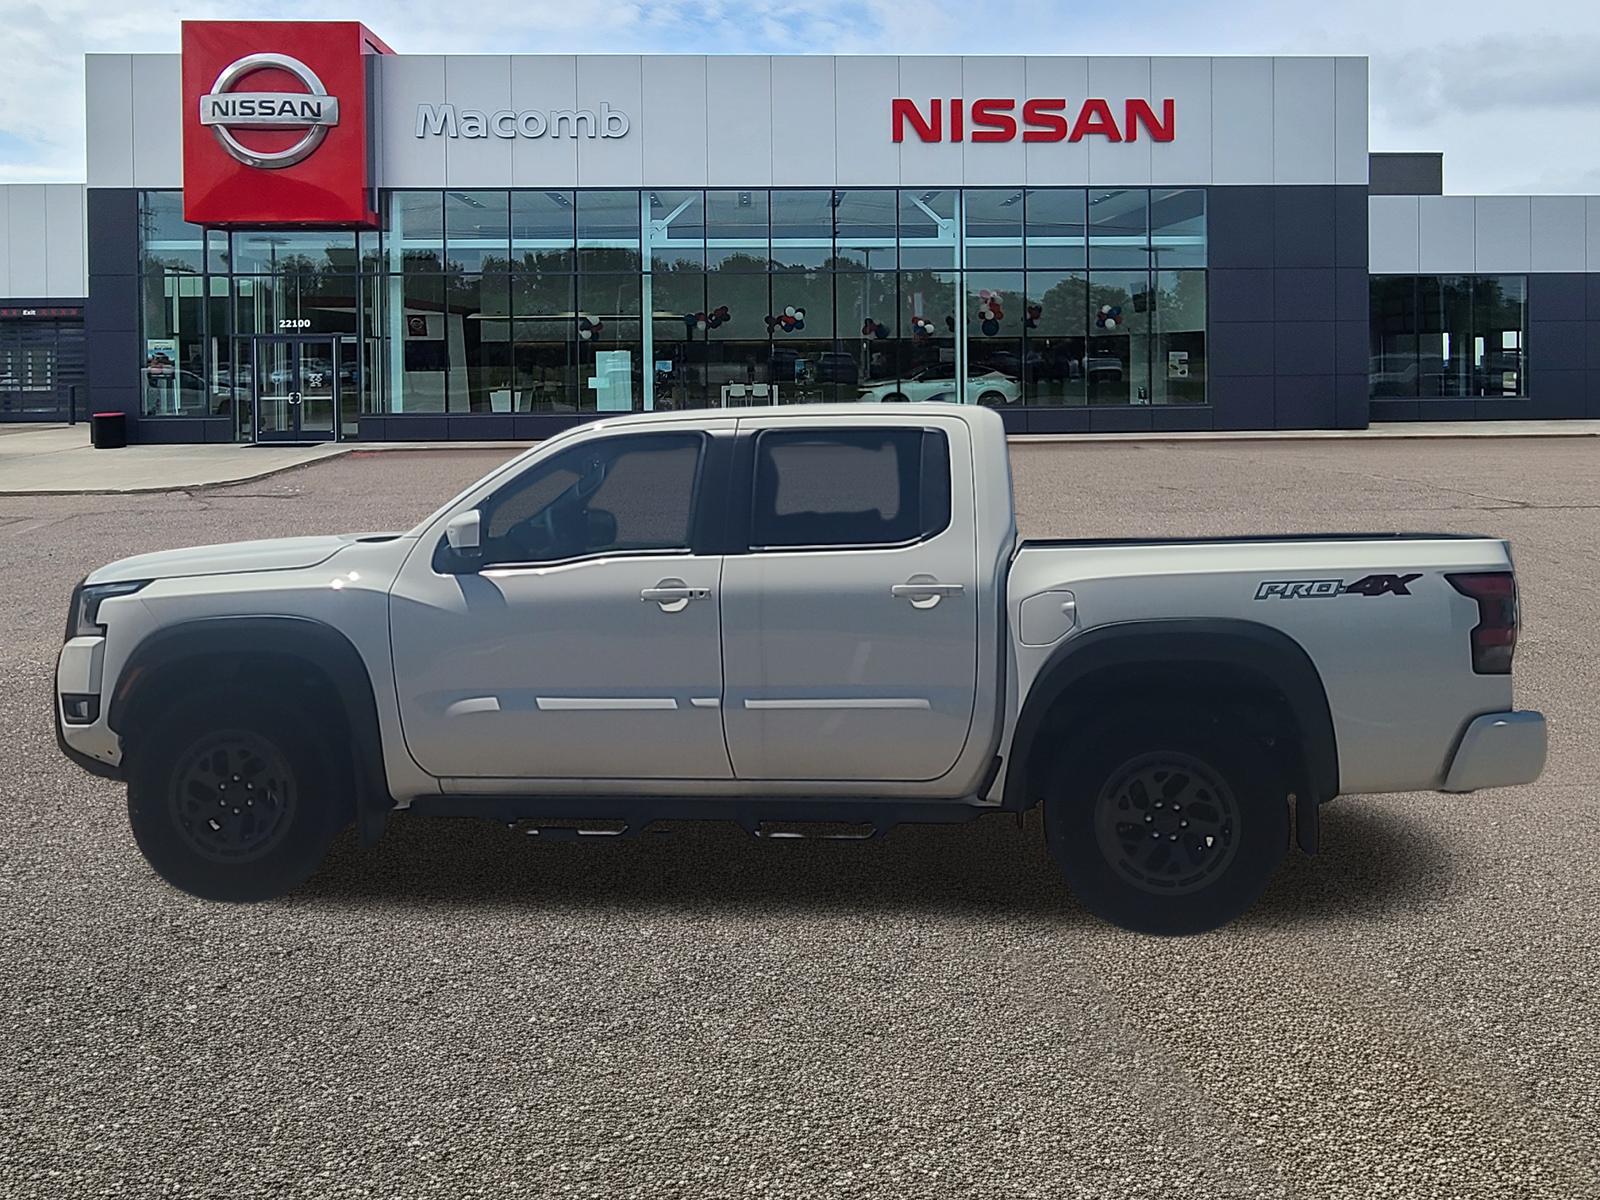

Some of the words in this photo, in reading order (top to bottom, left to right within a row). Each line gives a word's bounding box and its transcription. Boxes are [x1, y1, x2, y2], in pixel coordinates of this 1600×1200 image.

[211, 99, 322, 118] NISSAN
[415, 102, 630, 139] Macomb
[891, 98, 1175, 143] NISSAN
[279, 319, 311, 328] 22100
